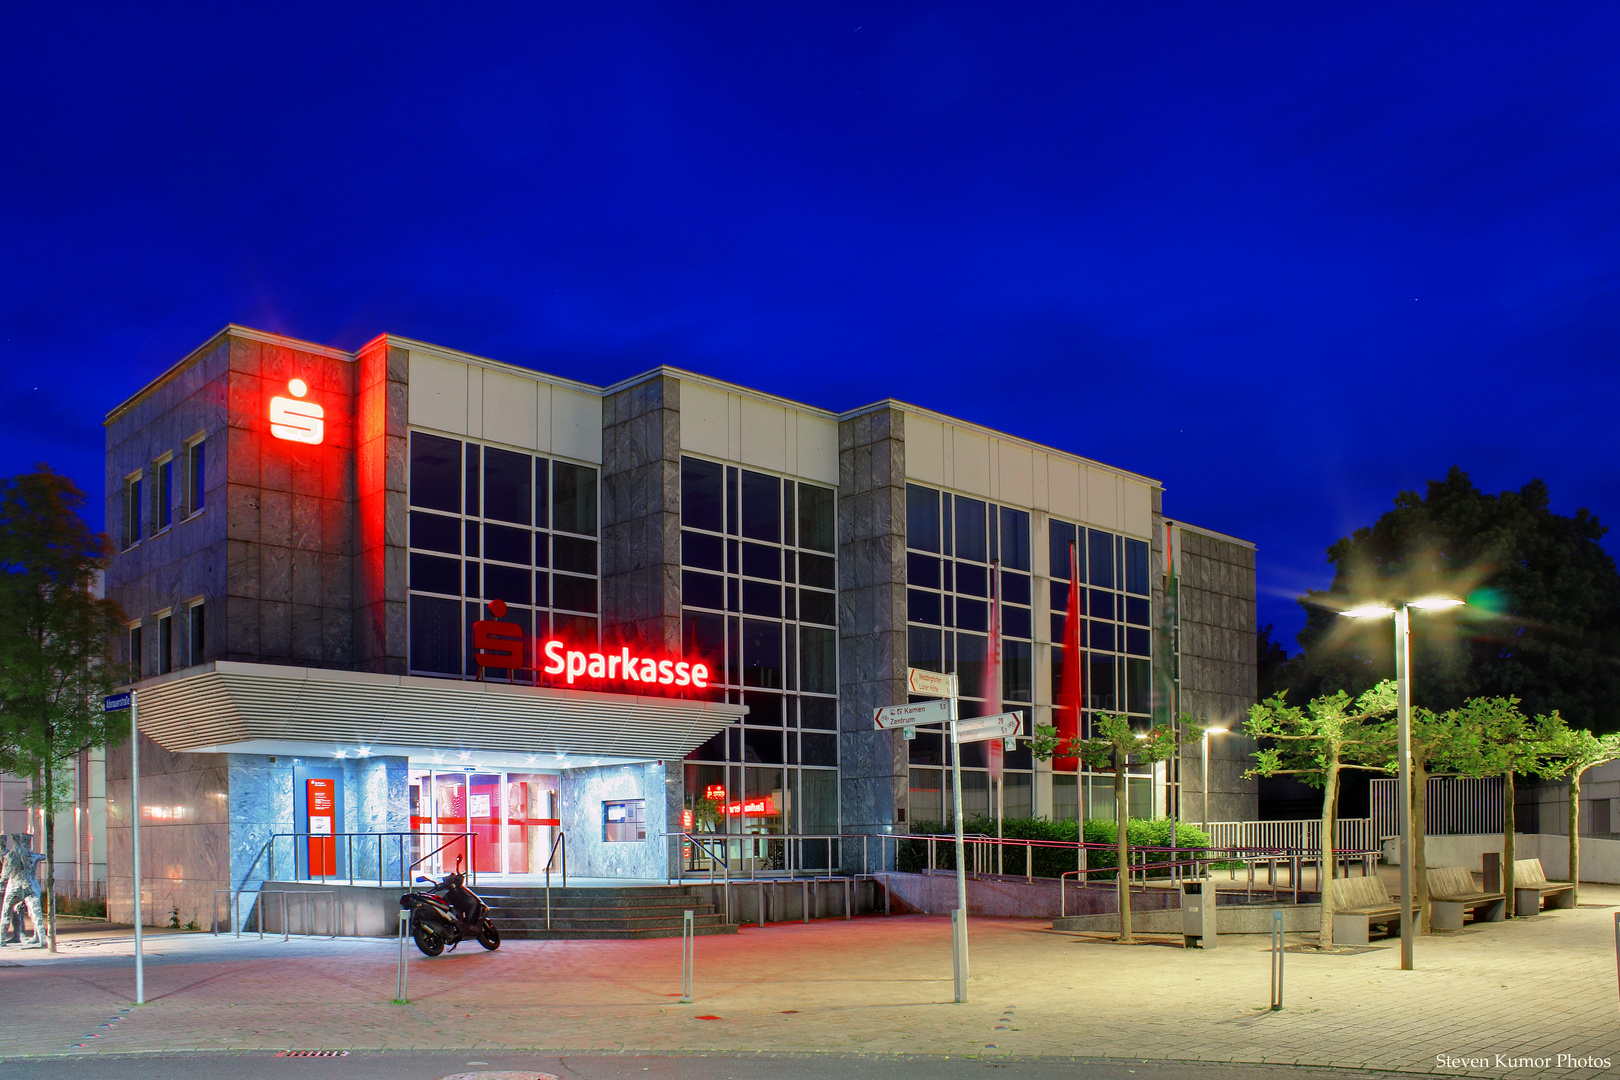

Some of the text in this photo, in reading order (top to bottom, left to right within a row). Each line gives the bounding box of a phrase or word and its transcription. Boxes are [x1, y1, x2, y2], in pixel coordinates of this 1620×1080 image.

[544, 640, 708, 688] Sparkasse
[904, 706, 926, 714] Kamen
[890, 717, 916, 726] Zentrum
[959, 721, 985, 730] Dortmund
